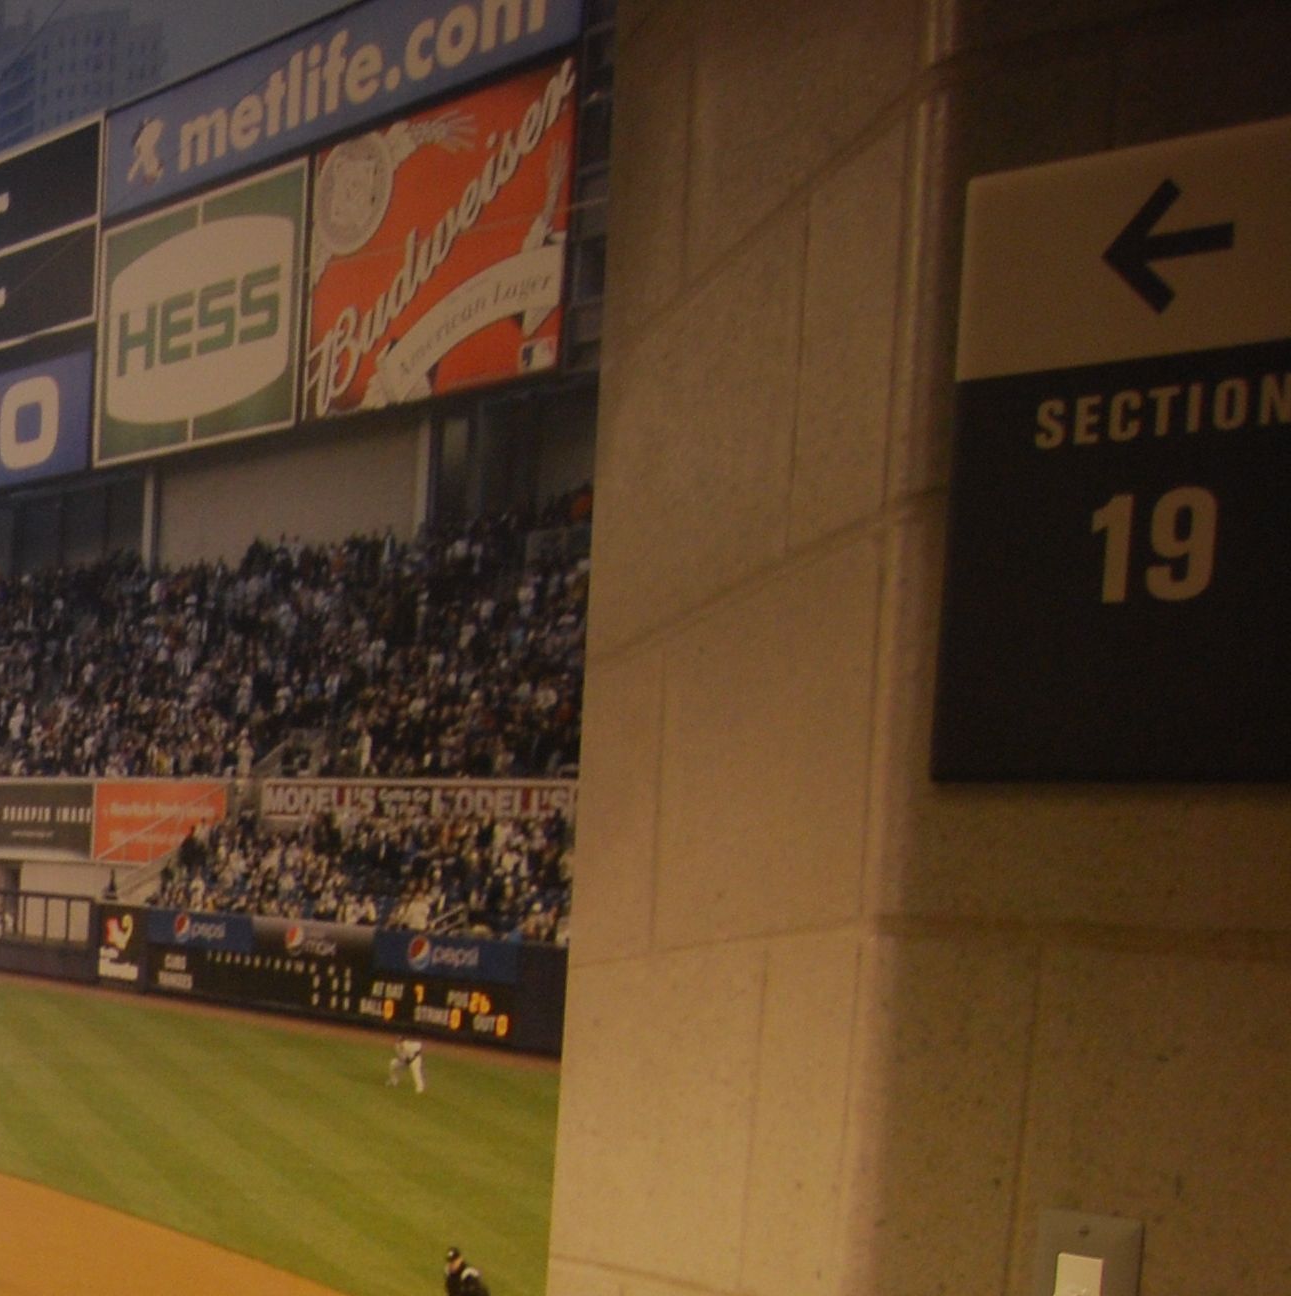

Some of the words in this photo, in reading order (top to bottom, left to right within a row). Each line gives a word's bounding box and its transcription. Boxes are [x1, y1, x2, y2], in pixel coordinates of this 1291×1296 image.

[178, 0, 547, 173] metlife.com
[305, 57, 576, 418] Budweiser
[116, 263, 282, 378] HESS
[1033, 370, 1291, 450] SECTION
[1089, 485, 1219, 604] 19
[431, 945, 480, 968] pepsi
